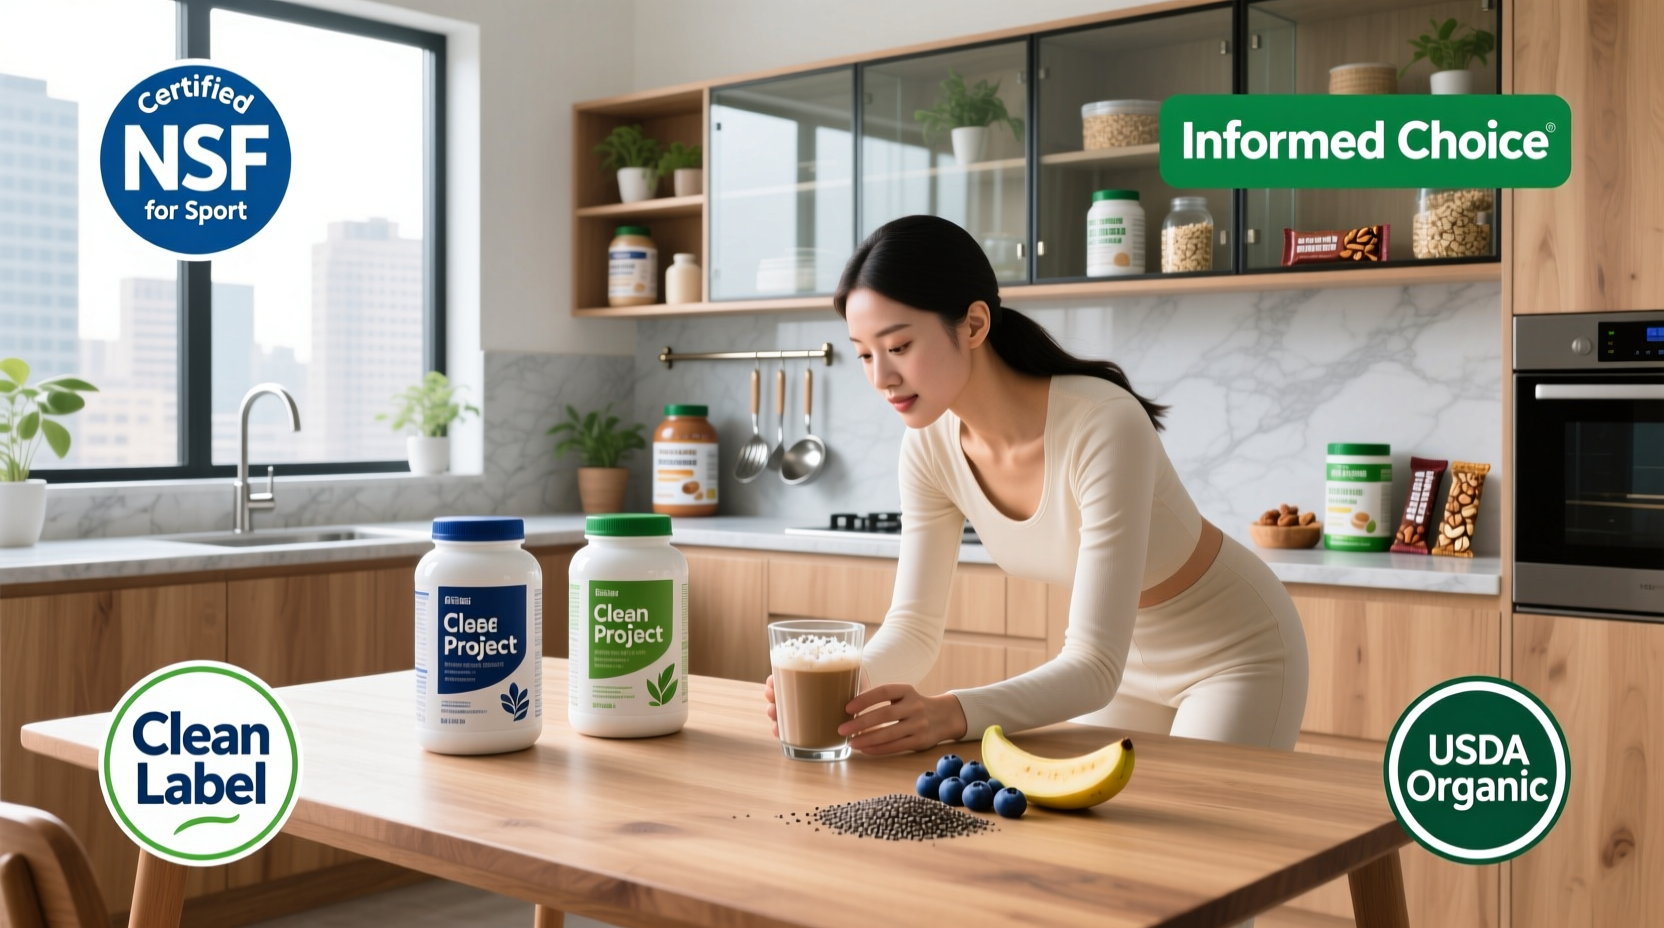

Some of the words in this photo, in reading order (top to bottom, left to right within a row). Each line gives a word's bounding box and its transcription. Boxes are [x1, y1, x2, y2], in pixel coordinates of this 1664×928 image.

[593, 603, 649, 623] Clean
[444, 635, 517, 661] Project
[594, 624, 664, 648] Project
